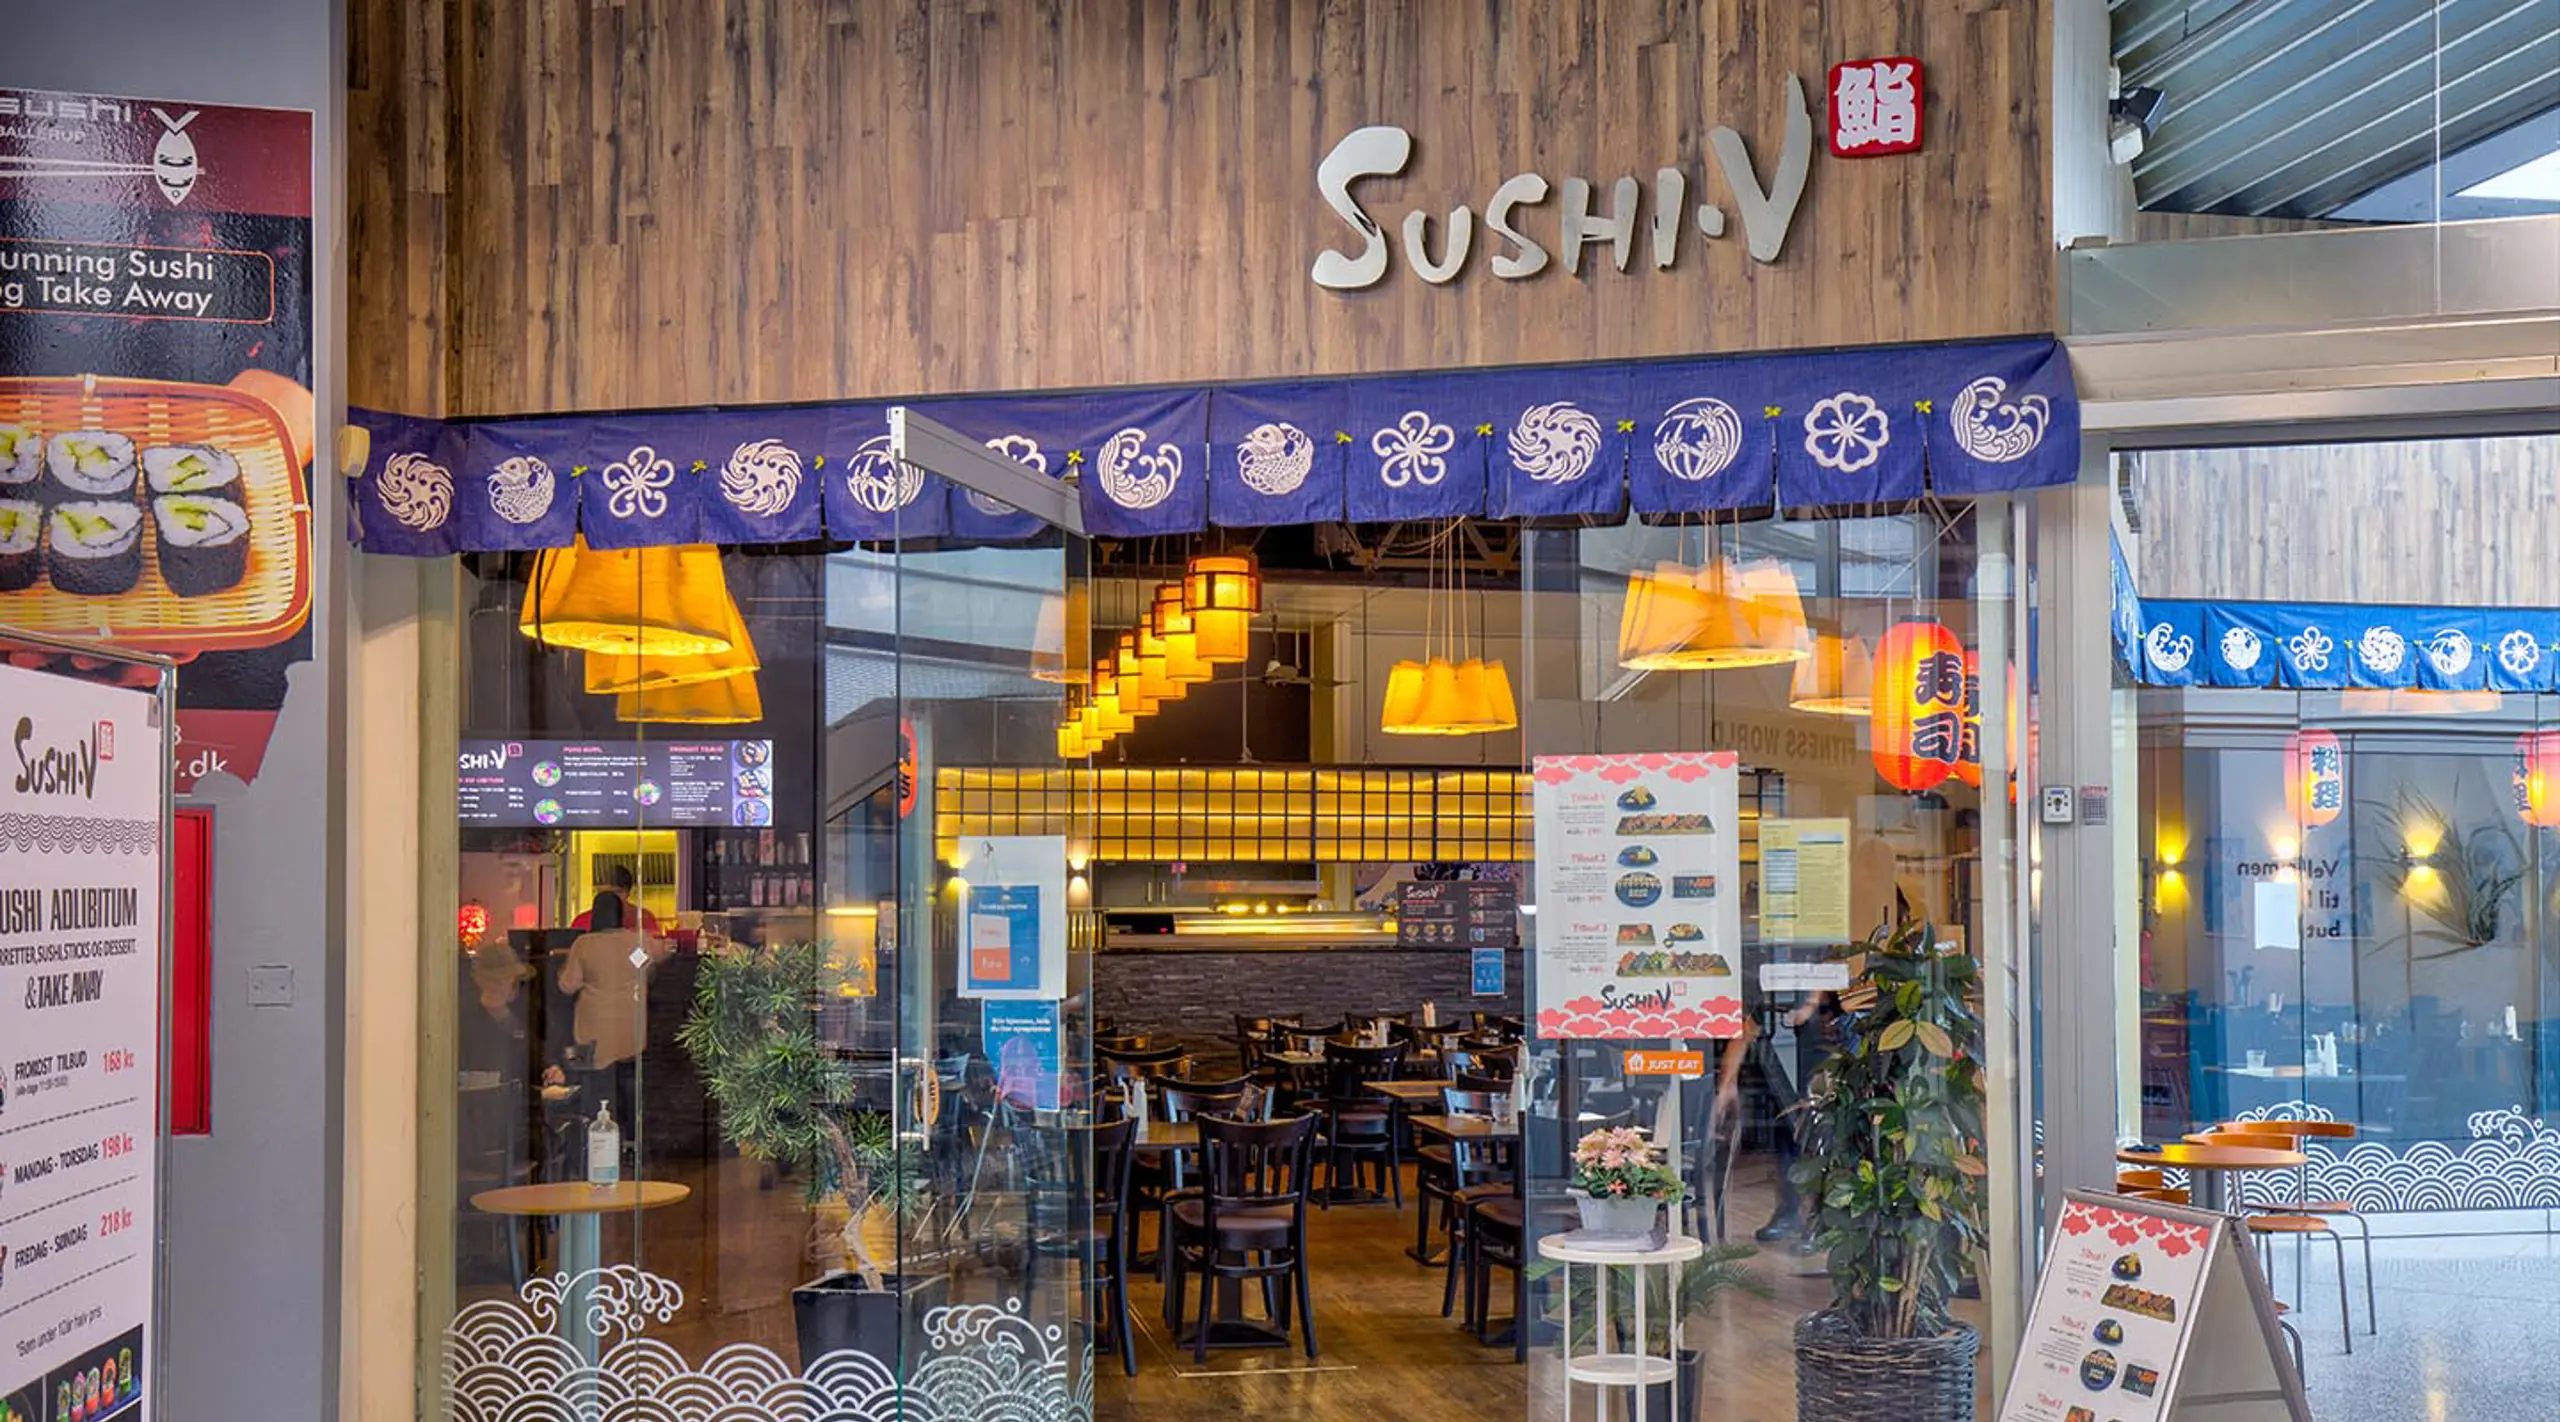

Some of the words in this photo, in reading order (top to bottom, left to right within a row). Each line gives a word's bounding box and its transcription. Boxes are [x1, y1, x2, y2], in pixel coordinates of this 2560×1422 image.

[128, 251, 214, 280] Sushi
[0, 282, 23, 307] g
[36, 277, 112, 305] Take
[123, 281, 214, 317] Away
[50, 887, 138, 931] ADLIBITUM
